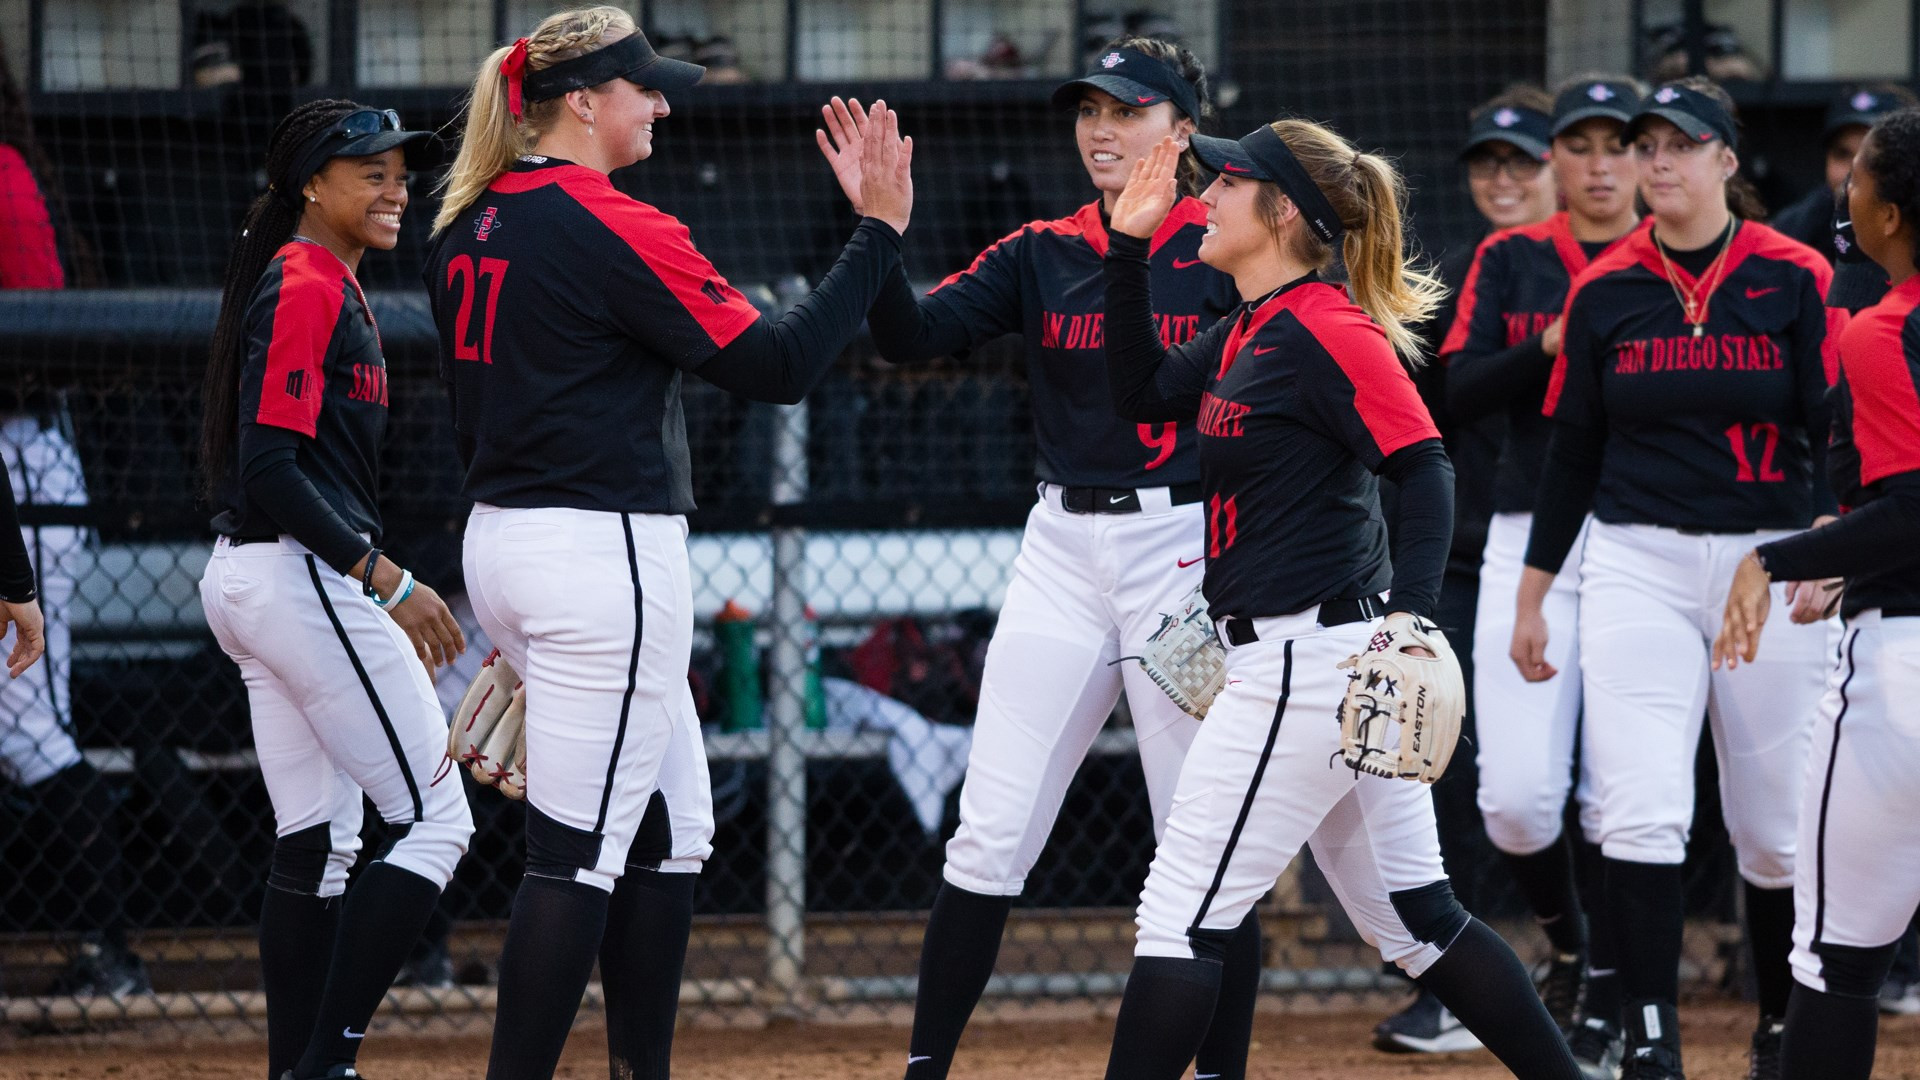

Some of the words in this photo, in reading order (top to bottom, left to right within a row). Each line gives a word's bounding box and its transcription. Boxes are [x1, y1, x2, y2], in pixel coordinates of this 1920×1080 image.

[1315, 218, 1333, 239] DRI-FIT
[447, 253, 510, 365] 27
[1064, 313, 1104, 349] DIE
[1153, 313, 1199, 350] ATE
[1650, 334, 1718, 372] DIEGO
[1721, 334, 1784, 370] STATE
[1724, 422, 1786, 482] 12
[1210, 491, 1238, 558] 11
[1412, 685, 1427, 753] EASTON
